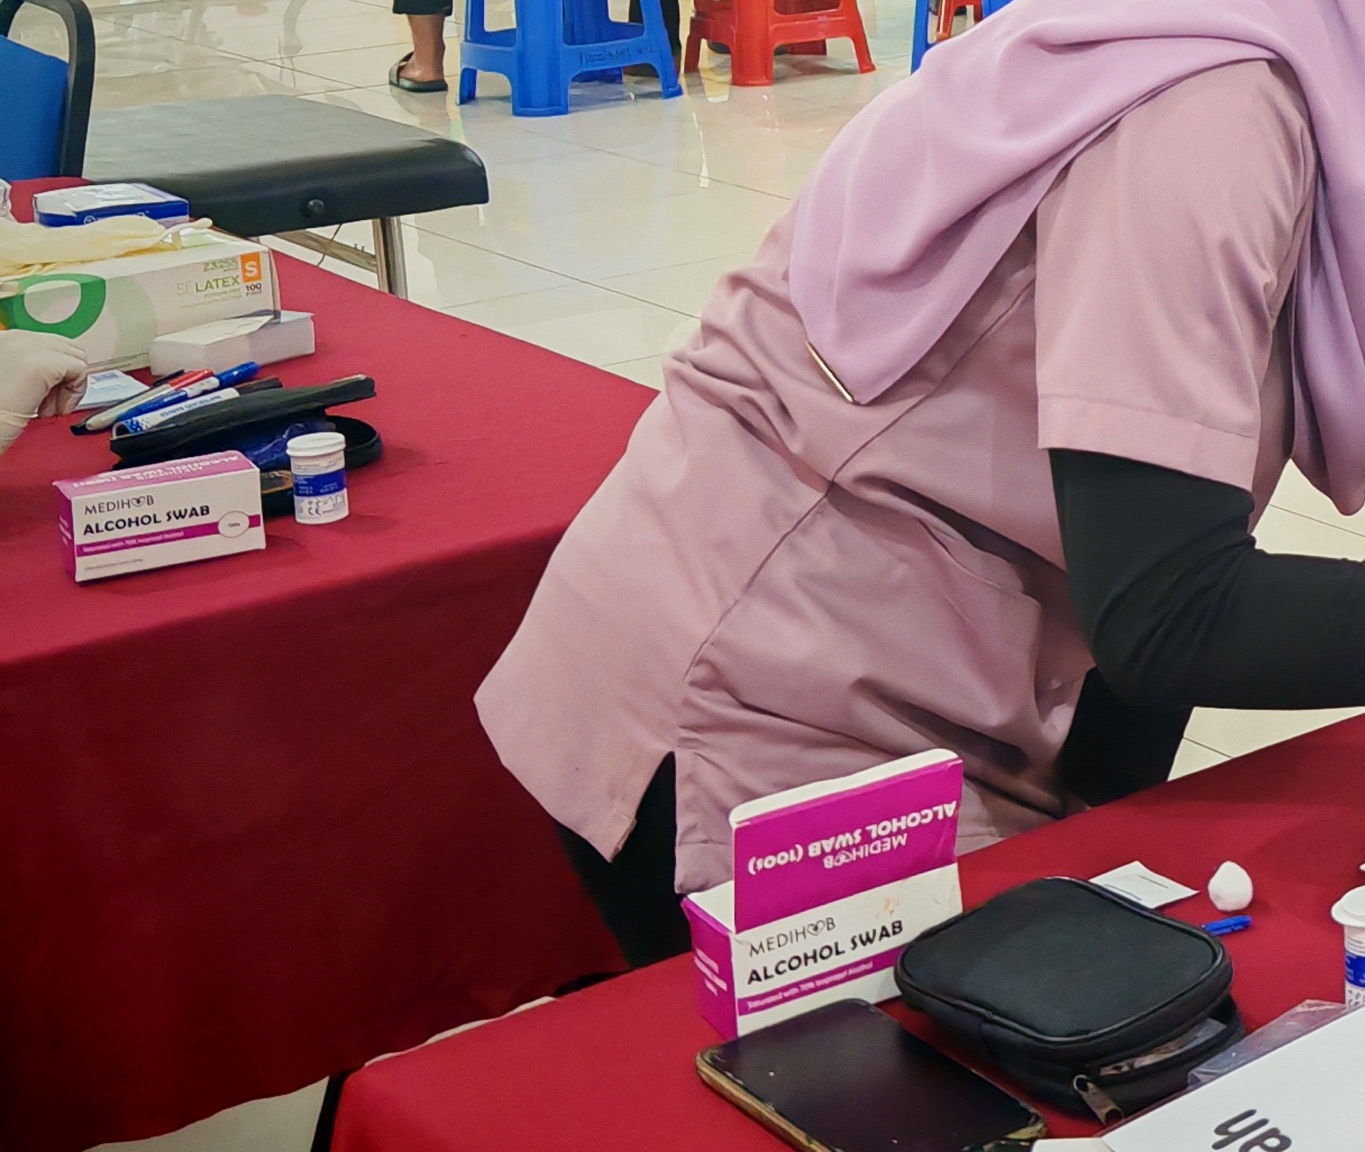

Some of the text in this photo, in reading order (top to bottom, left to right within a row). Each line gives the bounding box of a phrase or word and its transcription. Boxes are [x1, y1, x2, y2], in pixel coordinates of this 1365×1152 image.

[245, 261, 258, 277] S
[195, 274, 240, 293] LATEX
[245, 282, 262, 292] 100
[83, 513, 162, 536] ALCOHOL
[165, 505, 210, 522] SWAB
[748, 800, 957, 876] ALCOHOL SWAB (100s)
[747, 941, 846, 985] ALCOHOL
[850, 920, 904, 951] SWAB
